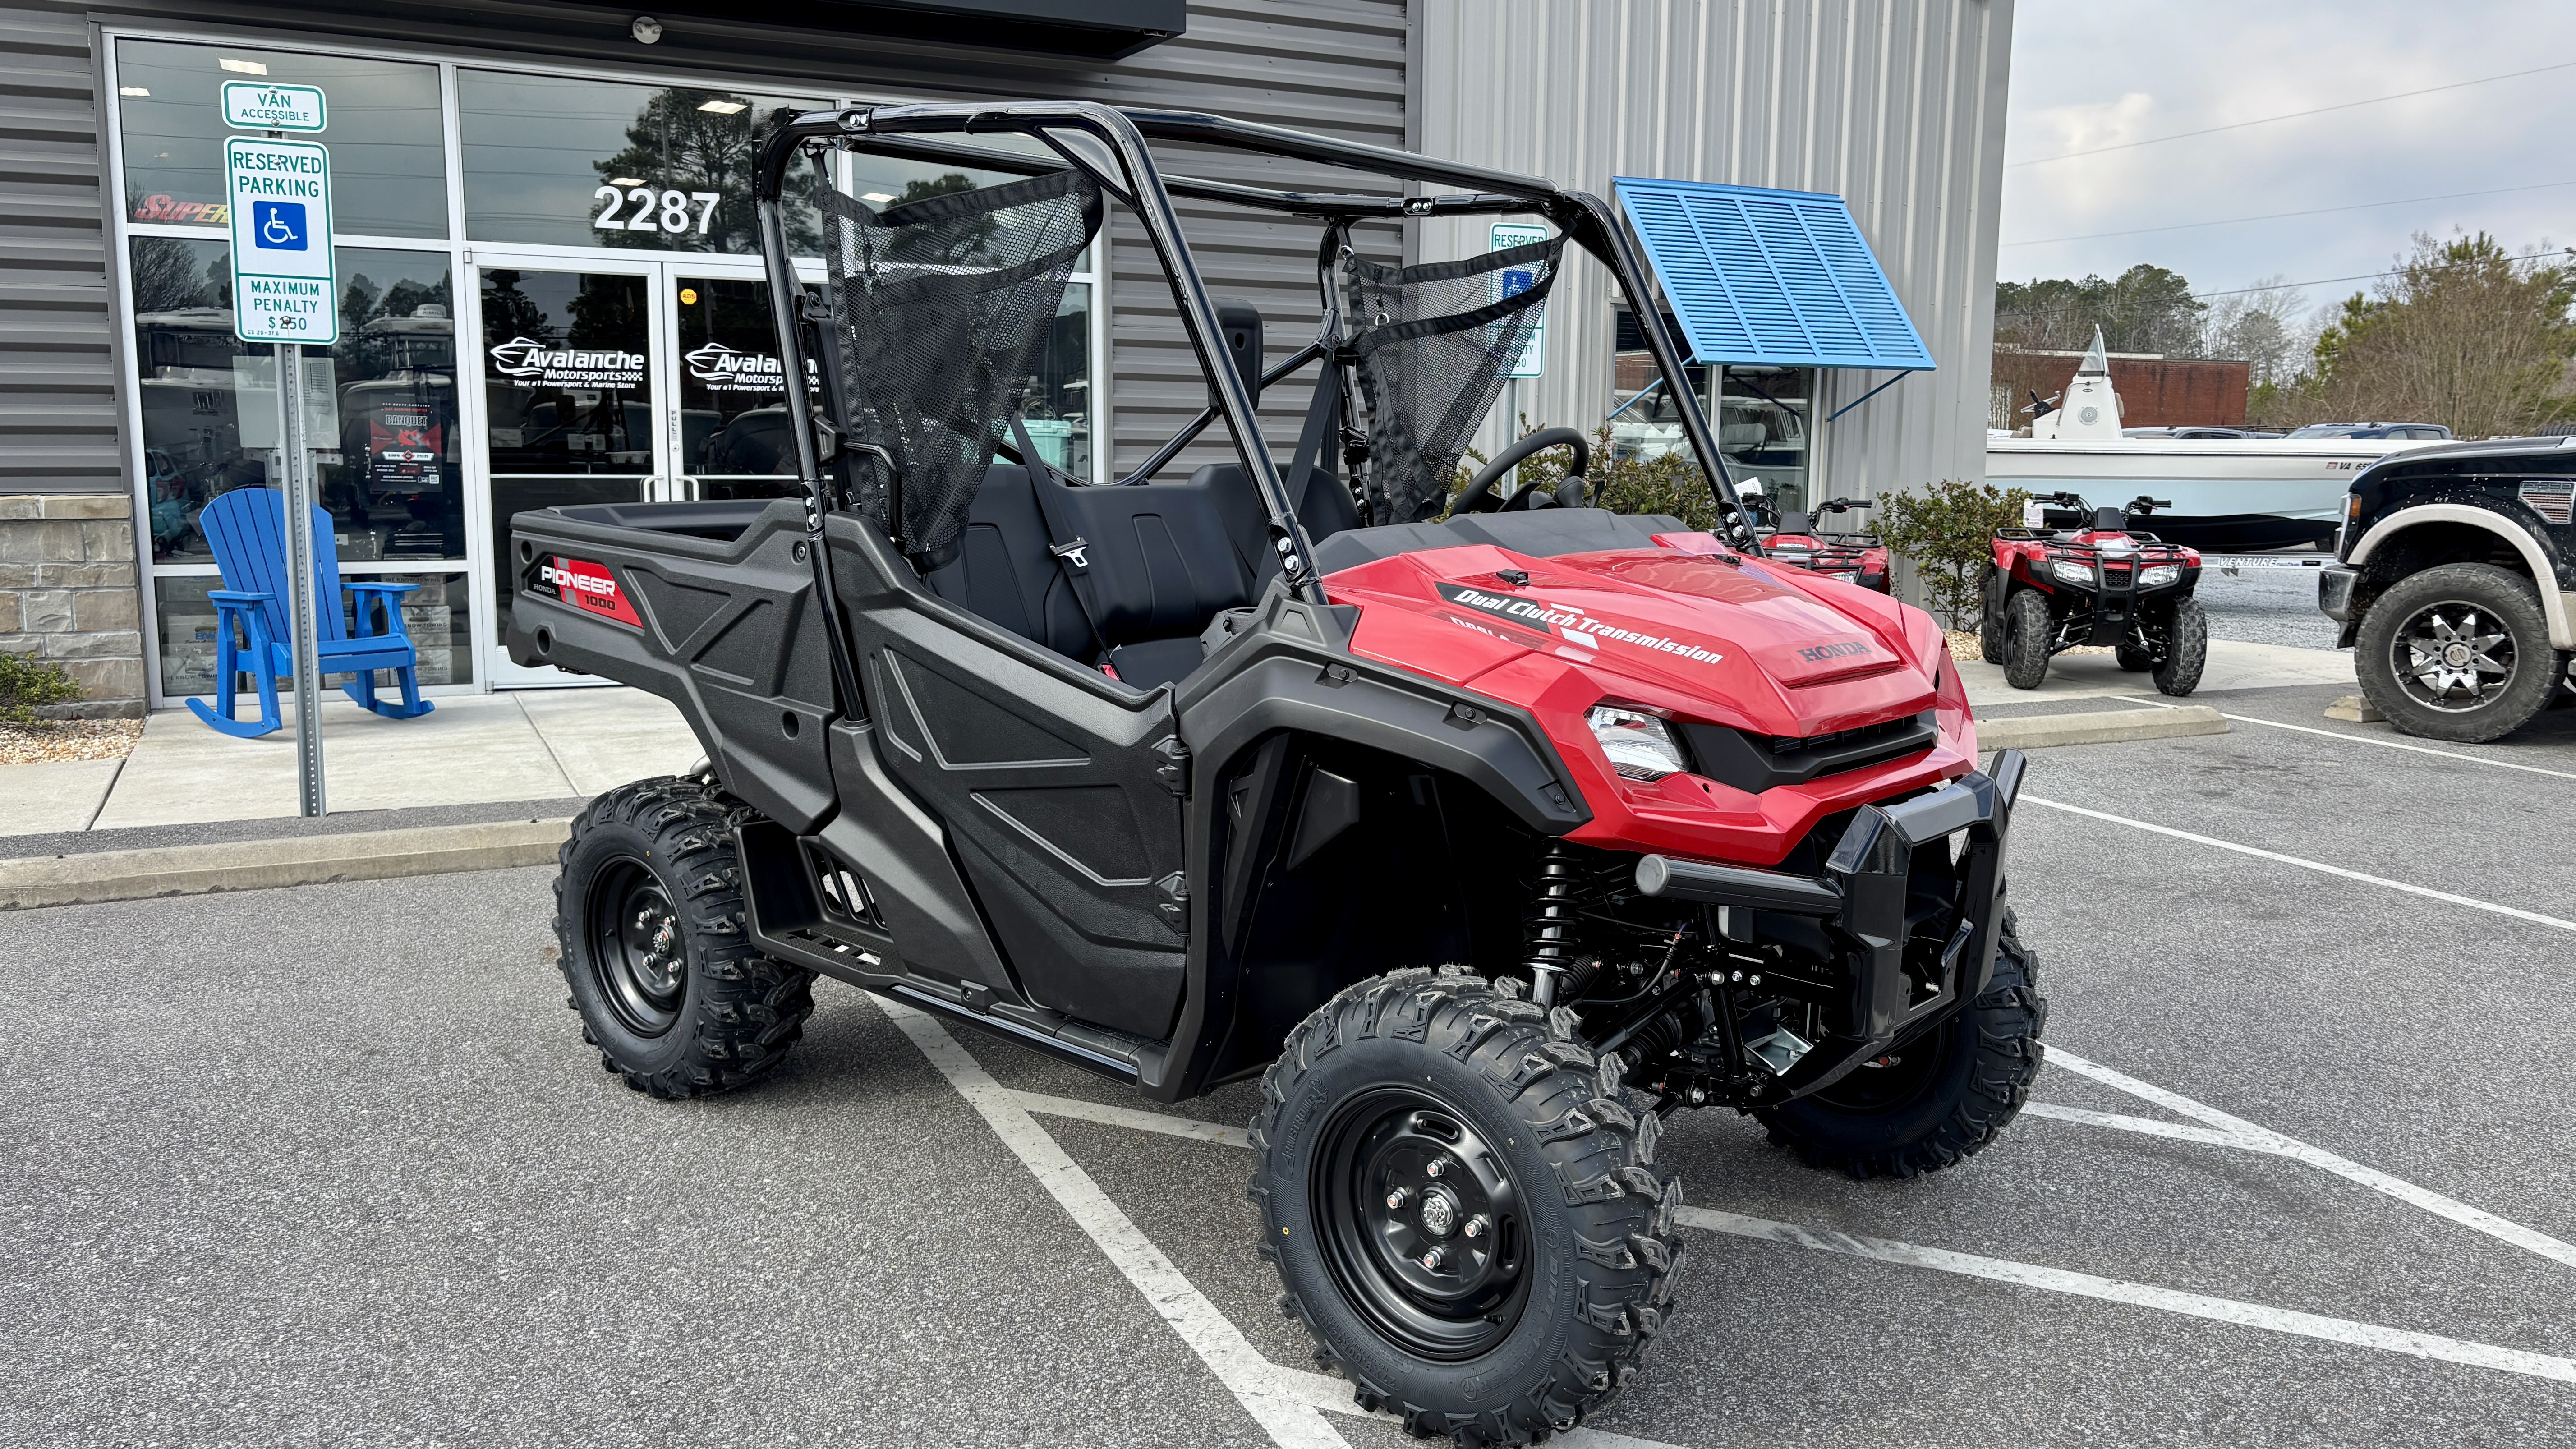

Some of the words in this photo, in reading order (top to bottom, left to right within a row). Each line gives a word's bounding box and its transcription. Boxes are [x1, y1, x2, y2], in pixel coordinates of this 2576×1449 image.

[258, 93, 291, 108] VAN
[241, 109, 309, 121] ACCESSIBLE
[233, 152, 322, 174] RESERVED
[239, 176, 319, 197] PARKING
[594, 186, 720, 234] 2287
[251, 280, 319, 296] MAXIMUM
[254, 298, 317, 313] PENALTY
[522, 348, 644, 370] Avalanche
[544, 369, 622, 382] Motorsports
[543, 380, 583, 388] Powersport
[386, 414, 428, 426] BANQUET
[2219, 557, 2278, 567] VENTURE
[534, 584, 556, 595] HONDA
[542, 566, 616, 597] PIONEER
[585, 594, 616, 610] 1000
[1454, 589, 1510, 610] Dual
[1506, 602, 1577, 627] Clutch
[1577, 617, 1723, 665] Transmission
[1796, 642, 1873, 663] HONDA
[1545, 1254, 1558, 1321] DIRT
